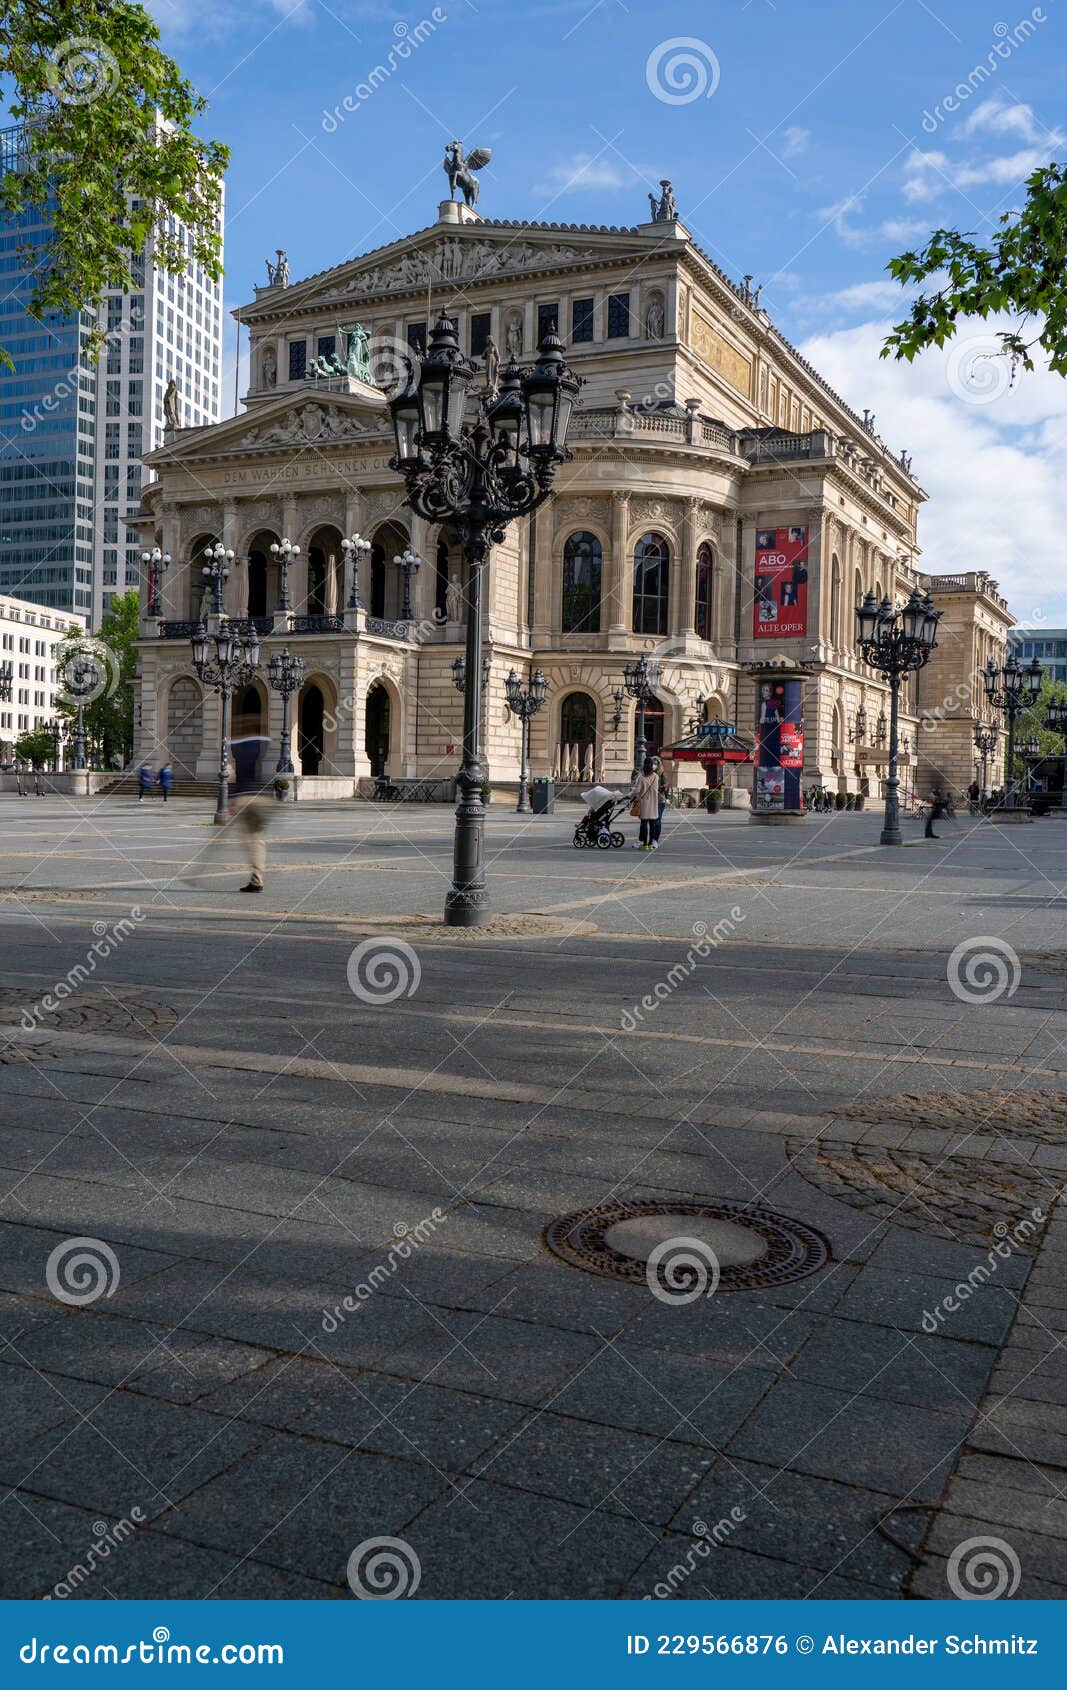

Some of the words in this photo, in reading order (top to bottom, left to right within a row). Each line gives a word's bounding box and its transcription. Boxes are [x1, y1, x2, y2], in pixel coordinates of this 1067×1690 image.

[224, 472, 247, 483] DEM
[252, 467, 299, 482] WAHREN
[305, 461, 367, 475] SCHOENEN
[760, 555, 786, 565] ABO
[758, 624, 780, 632] ALTE
[781, 623, 803, 632] OPER
